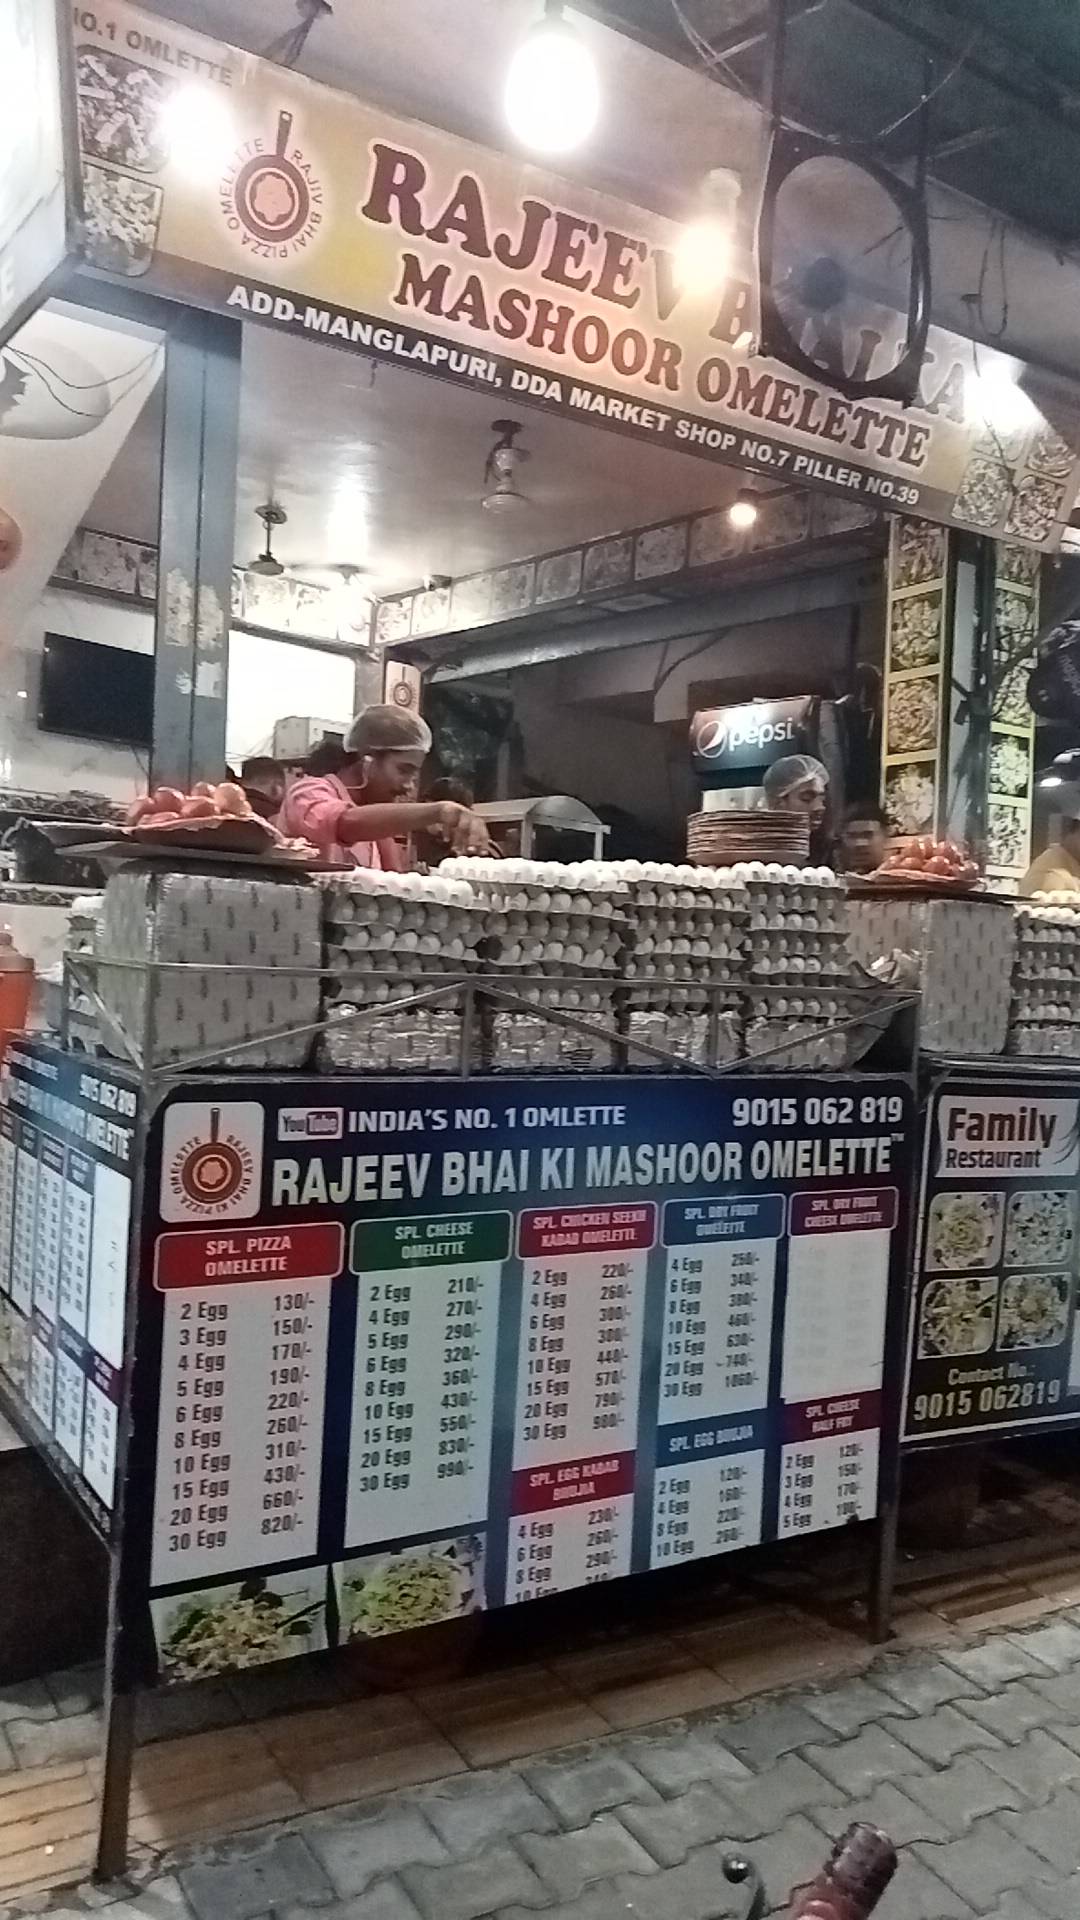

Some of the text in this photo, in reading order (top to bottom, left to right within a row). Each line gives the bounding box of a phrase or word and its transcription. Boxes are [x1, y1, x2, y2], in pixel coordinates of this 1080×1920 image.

[73, 7, 233, 88] O.1 OMLETTE
[291, 150, 322, 206] RAJIV
[361, 143, 694, 322] RAJEEV
[242, 233, 288, 258] PIZZA
[393, 253, 931, 467] MASHOOR OMELETTE
[227, 285, 920, 504] ADD-MANGLAPURI, DDA MARKET SHOP NO.7 PILLER NO.39
[729, 717, 793, 751] pepsi
[349, 1108, 448, 1132] INDIA'S
[454, 1107, 498, 1130] NO.
[522, 1105, 627, 1128] OMLETTE
[732, 1096, 903, 1126] 9015 062 819
[947, 1106, 1058, 1148] Family
[945, 1148, 1042, 1168] Restaurant
[272, 1153, 431, 1206] RAJEEV
[441, 1149, 529, 1197] BHAI
[540, 1147, 576, 1191] KI
[586, 1141, 743, 1187] MASHOOR
[425, 1222, 474, 1238] CHEESE
[560, 1212, 610, 1227] CHICKEN
[246, 1236, 292, 1252] PIZZA
[401, 1241, 466, 1259] OMELETTE
[205, 1256, 287, 1277] OMELETTE
[532, 1270, 541, 1286] 2
[545, 1269, 567, 1287] Egg
[671, 1258, 679, 1271] 4
[682, 1257, 703, 1274] Egg
[370, 1286, 380, 1301] 2
[384, 1284, 411, 1303] Egg
[180, 1293, 314, 1321] 2 Egg 130/-
[368, 1310, 378, 1325] 4
[383, 1308, 410, 1326] Egg
[179, 1317, 313, 1347] 3 Egg 150/-
[367, 1333, 377, 1349] 5
[382, 1332, 408, 1350] Egg
[178, 1341, 311, 1373] 4 Egg 170/-
[366, 1357, 375, 1373] 6
[380, 1356, 406, 1374] Egg
[527, 1359, 544, 1375] 10
[547, 1357, 571, 1374] Egg
[177, 1366, 309, 1398] 5 Egg 190/-
[365, 1381, 374, 1396] 8
[379, 1379, 406, 1397] Egg
[527, 1381, 542, 1397] 15
[546, 1379, 569, 1396] Egg
[175, 1392, 309, 1423] 6 Egg 220/-
[365, 1403, 383, 1420] 10
[387, 1401, 414, 1420] Egg
[524, 1402, 541, 1419] 20
[545, 1401, 568, 1418] Egg
[913, 1379, 1061, 1421] 9015 062819
[174, 1415, 308, 1449] 8 Egg 260/-
[364, 1427, 381, 1444] 15
[386, 1425, 413, 1443] Egg
[173, 1439, 306, 1474] 10 Egg 310/-
[360, 1450, 380, 1468] 20
[385, 1448, 411, 1467] Egg
[172, 1463, 305, 1500] 15 Egg 430/-
[360, 1475, 379, 1492] 30
[384, 1472, 410, 1490] Egg
[169, 1488, 304, 1526] 20 Egg 660/-
[169, 1513, 303, 1552] 30 Egg 820/-
[530, 1522, 554, 1539] Egg
